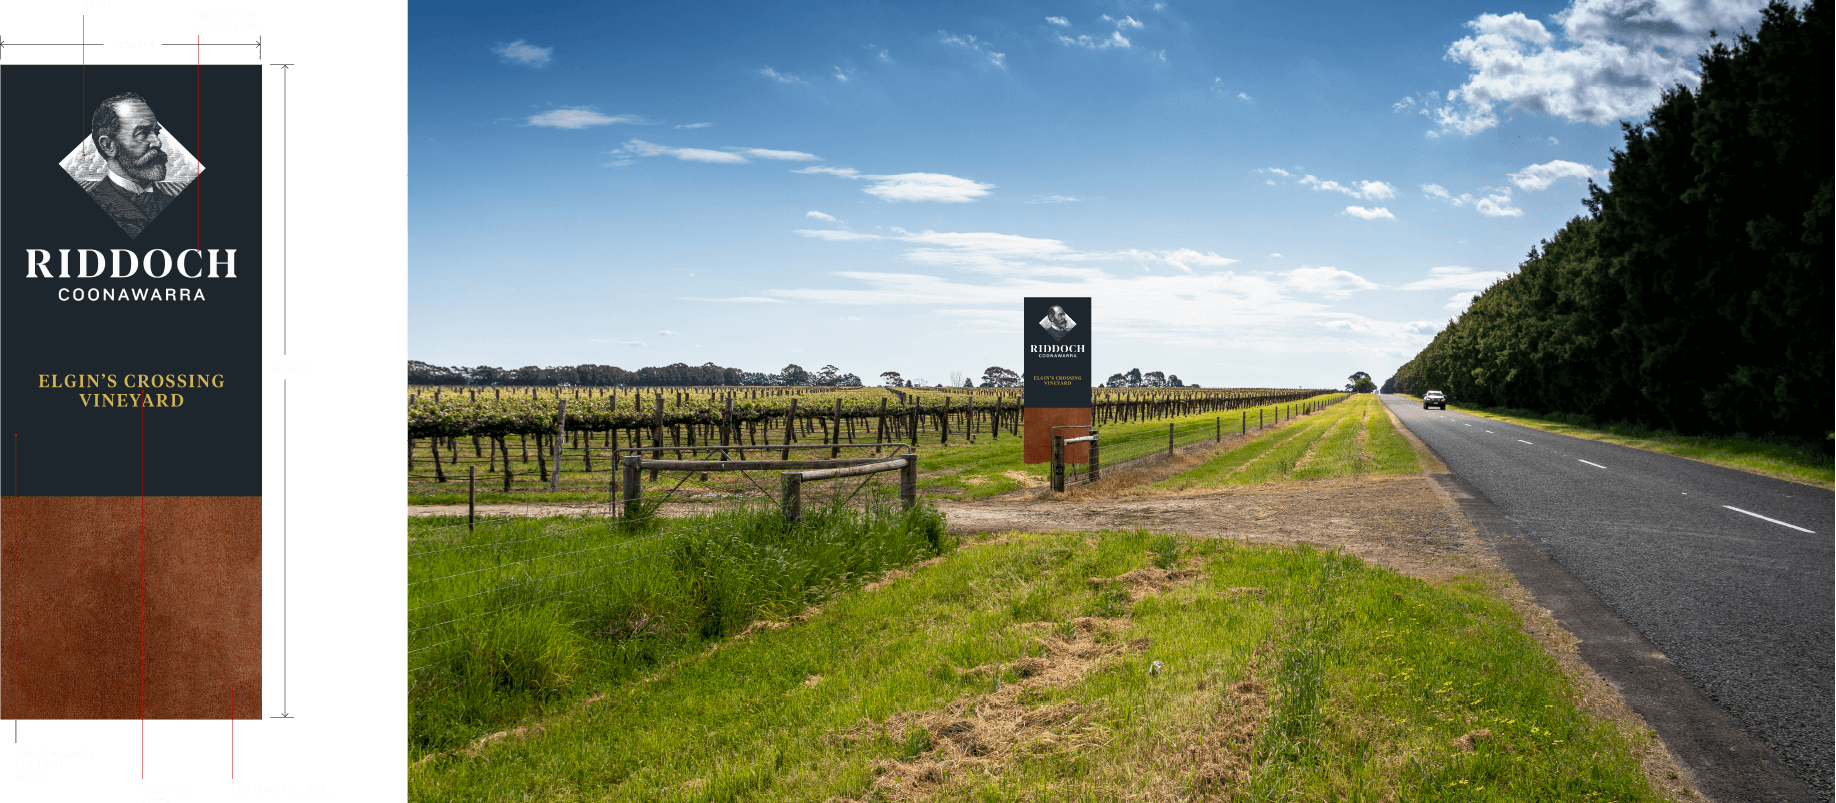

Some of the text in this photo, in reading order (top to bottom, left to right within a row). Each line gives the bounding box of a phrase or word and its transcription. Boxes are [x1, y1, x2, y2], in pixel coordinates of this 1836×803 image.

[26, 249, 237, 278] RIDDOCH
[59, 288, 205, 301] COONAWARRA
[1031, 345, 1086, 353] RIDDOCH
[124, 374, 224, 388] CROSSING
[79, 394, 183, 407] VINEYARD
